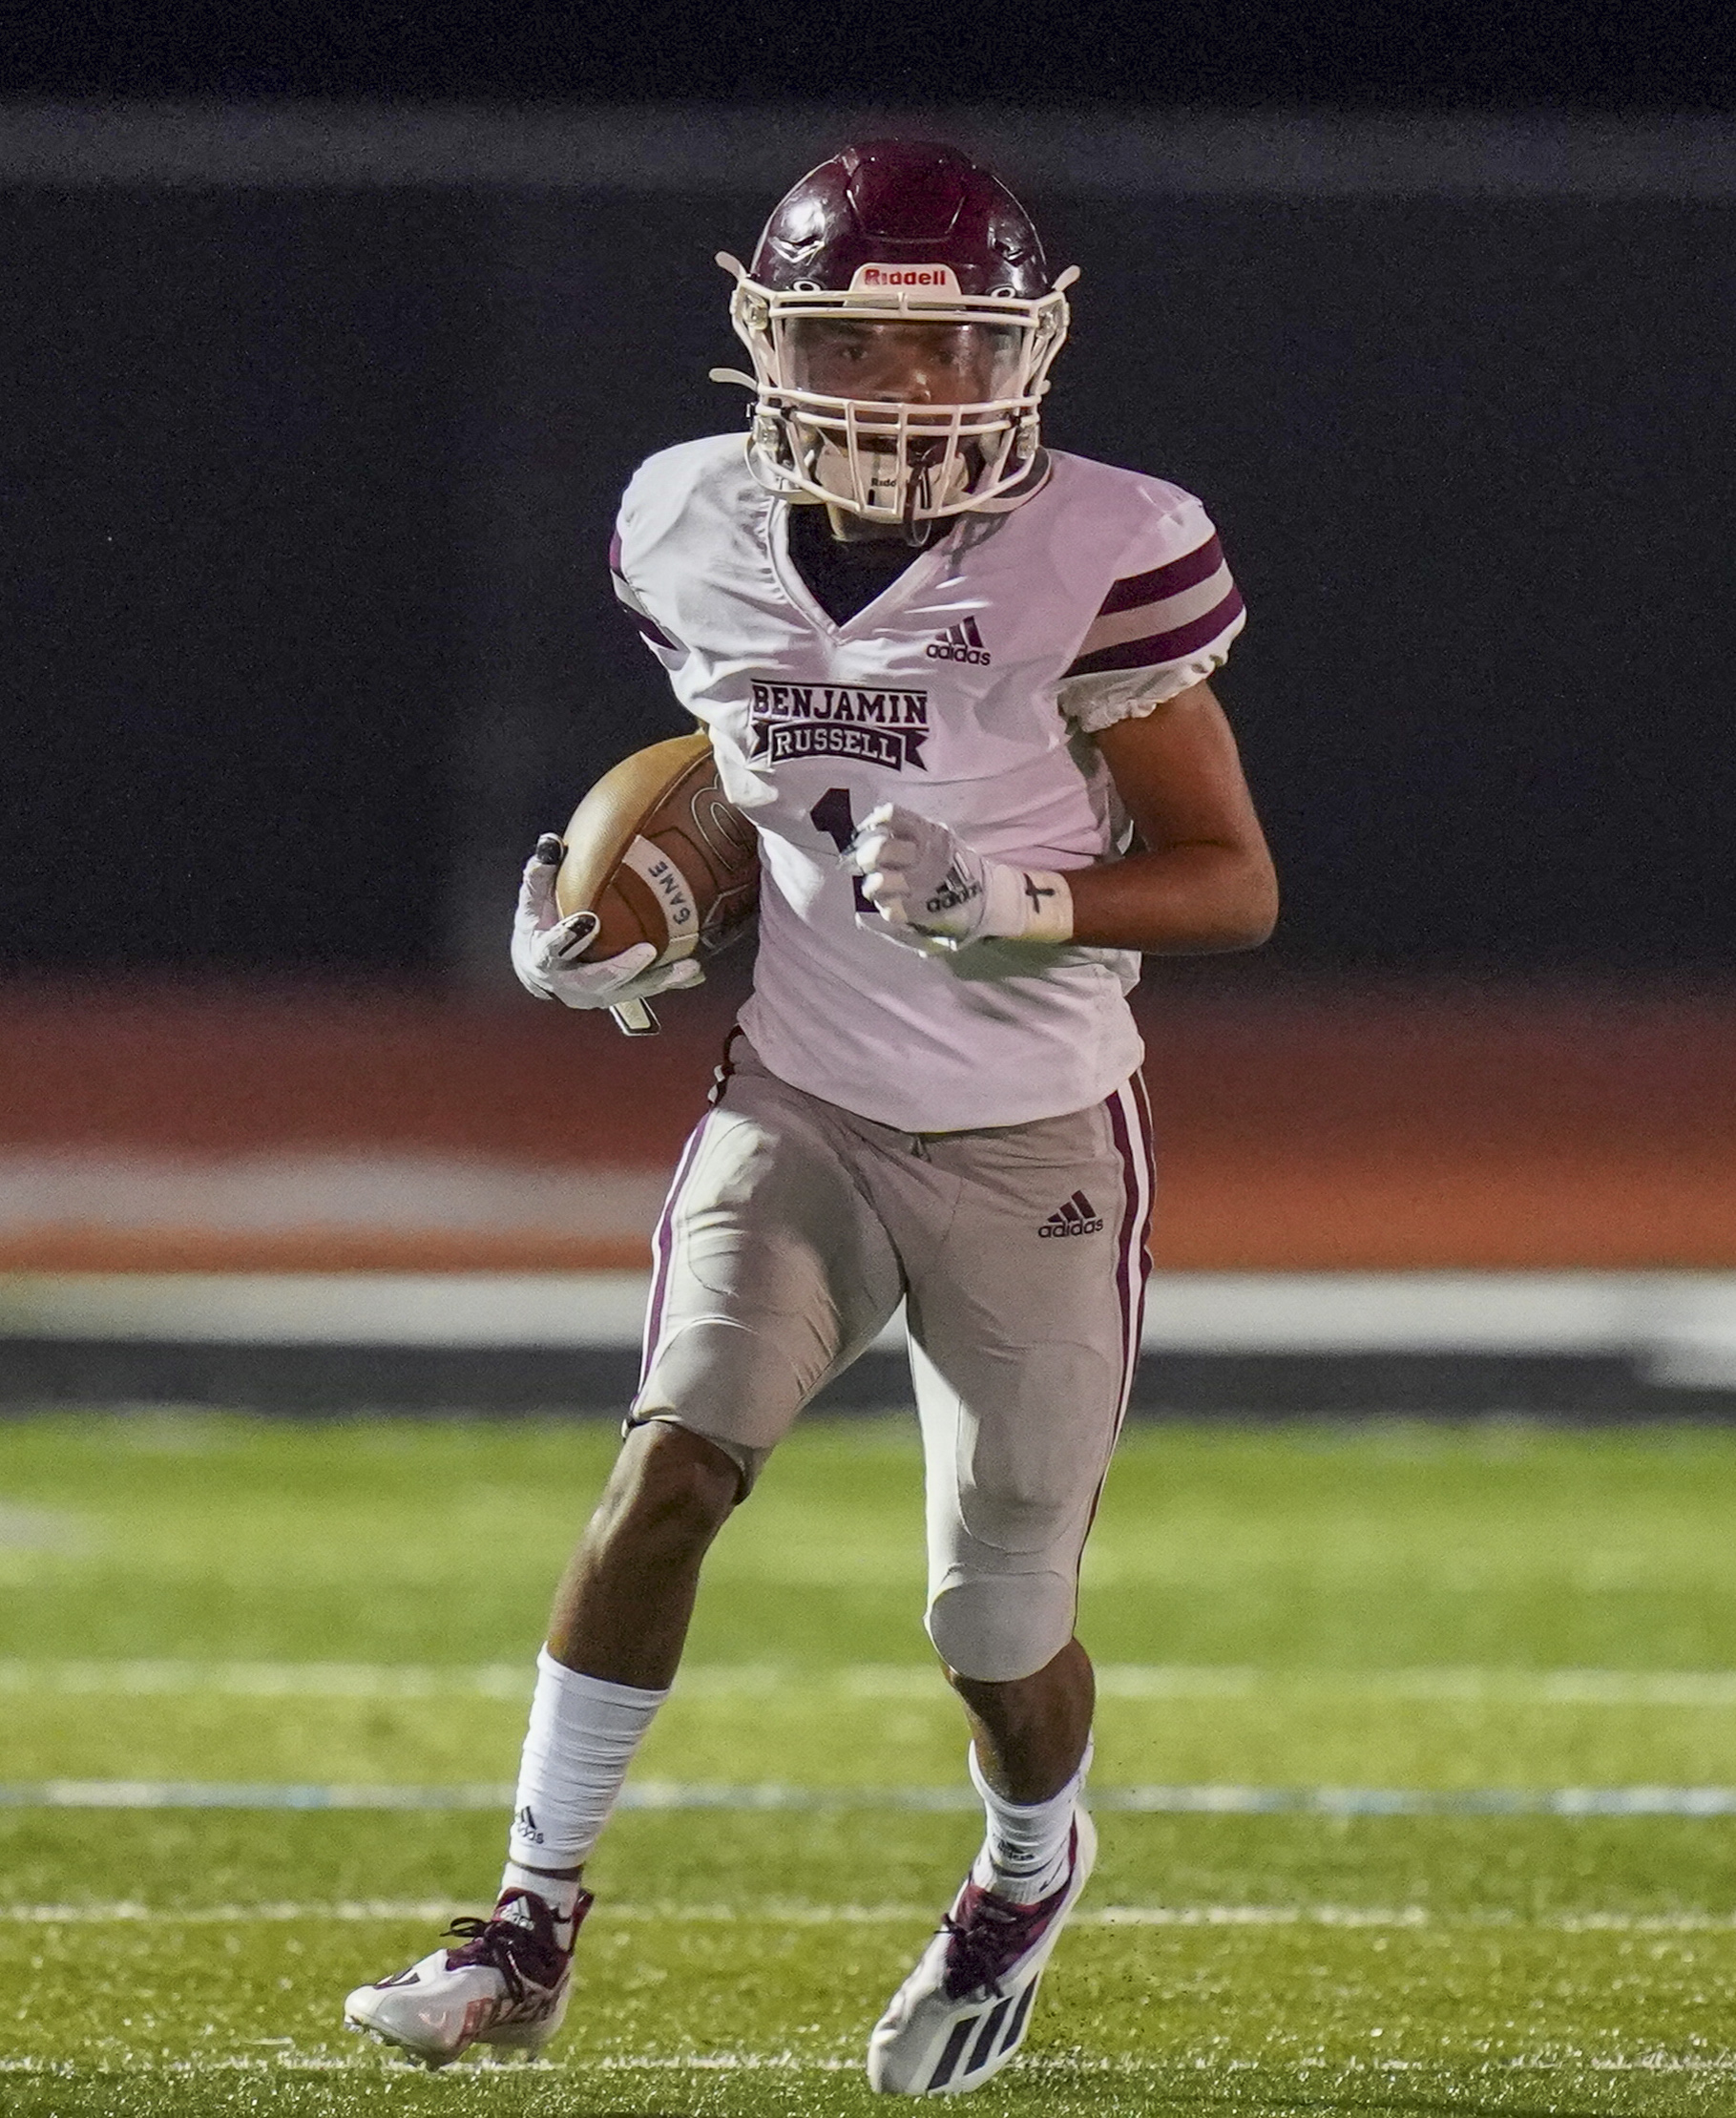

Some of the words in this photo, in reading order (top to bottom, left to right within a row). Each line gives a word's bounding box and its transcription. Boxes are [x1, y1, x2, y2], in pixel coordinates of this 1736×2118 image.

[865, 268, 947, 286] Riddell
[926, 641, 992, 666] adidas
[752, 684, 929, 724] BENJAMIN
[774, 728, 897, 765] RUSSELL
[810, 787, 882, 913] 1
[1037, 1217, 1104, 1238] adidas
